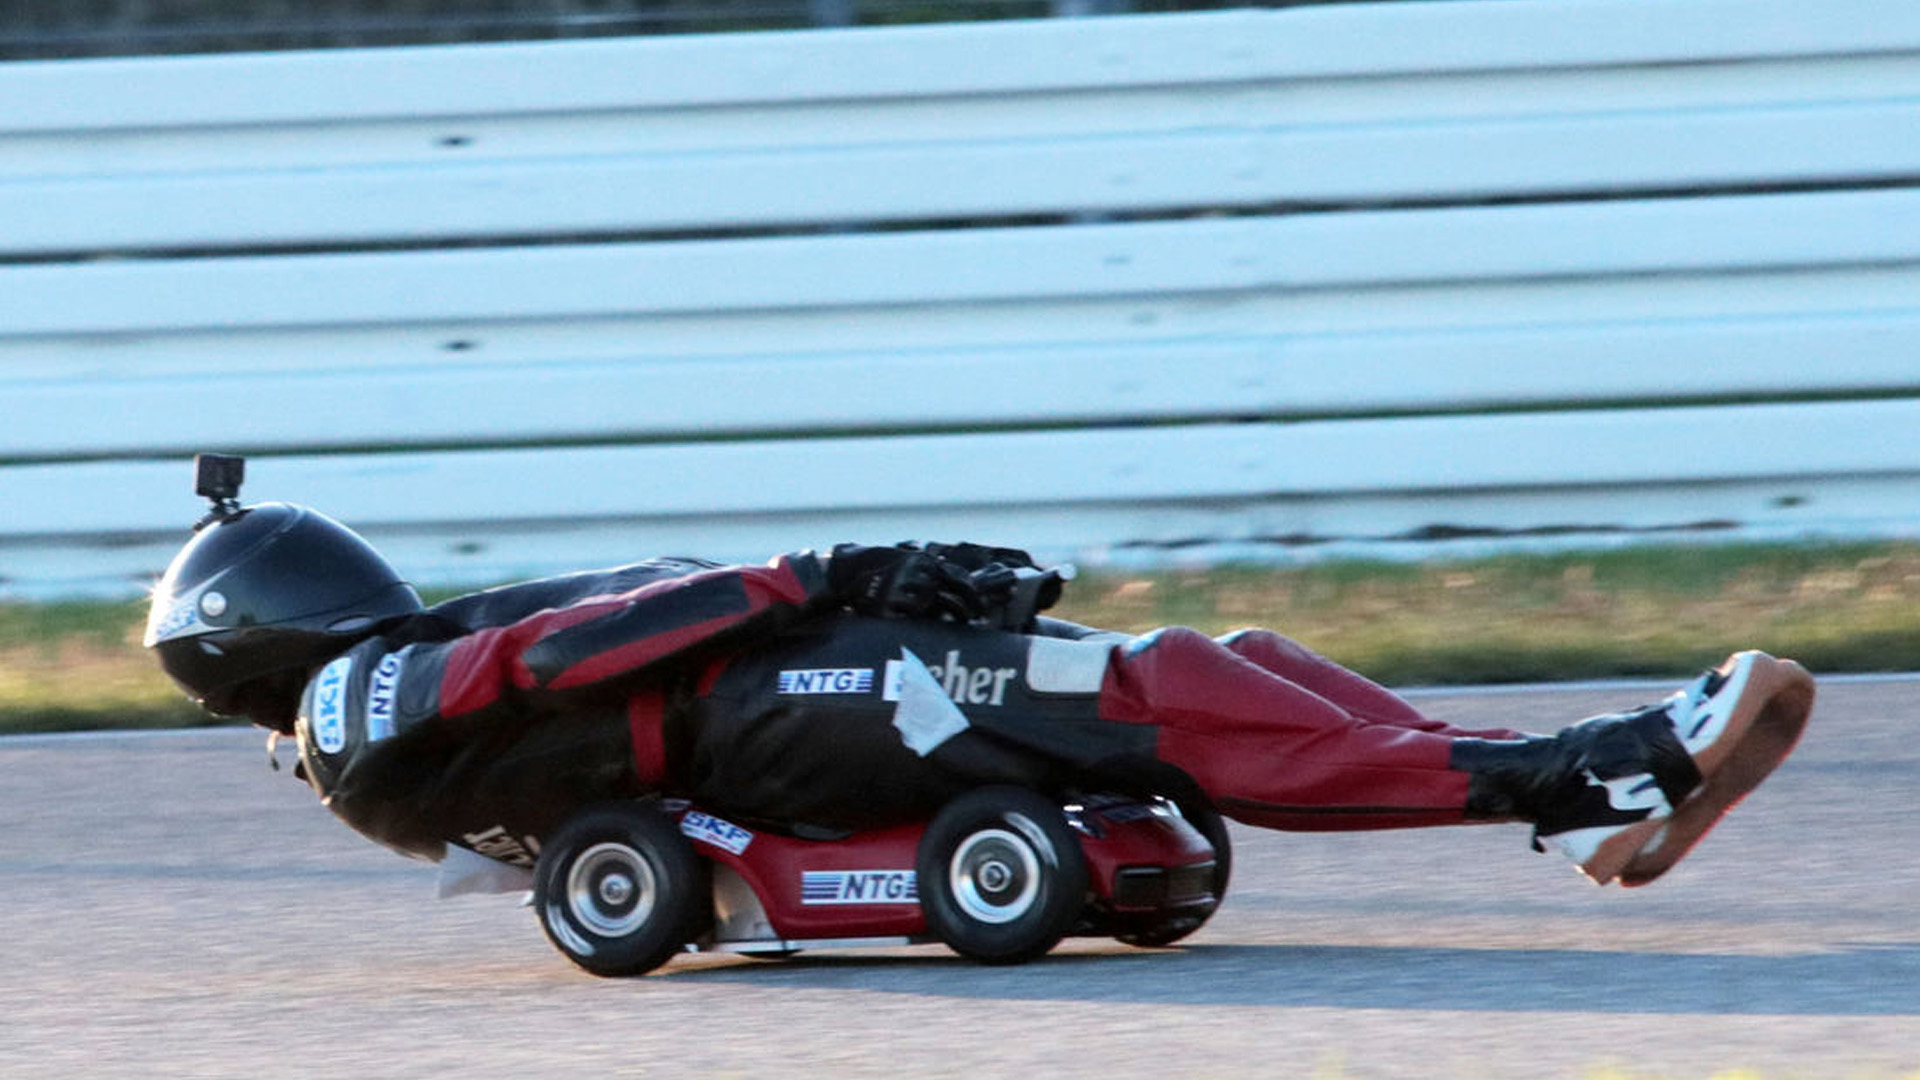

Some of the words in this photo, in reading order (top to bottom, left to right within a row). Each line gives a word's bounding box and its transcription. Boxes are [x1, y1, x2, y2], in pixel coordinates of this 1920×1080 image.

[371, 660, 399, 716] NTG
[793, 670, 854, 692] NTG
[684, 812, 751, 840] SKF
[843, 873, 904, 900] NTG
